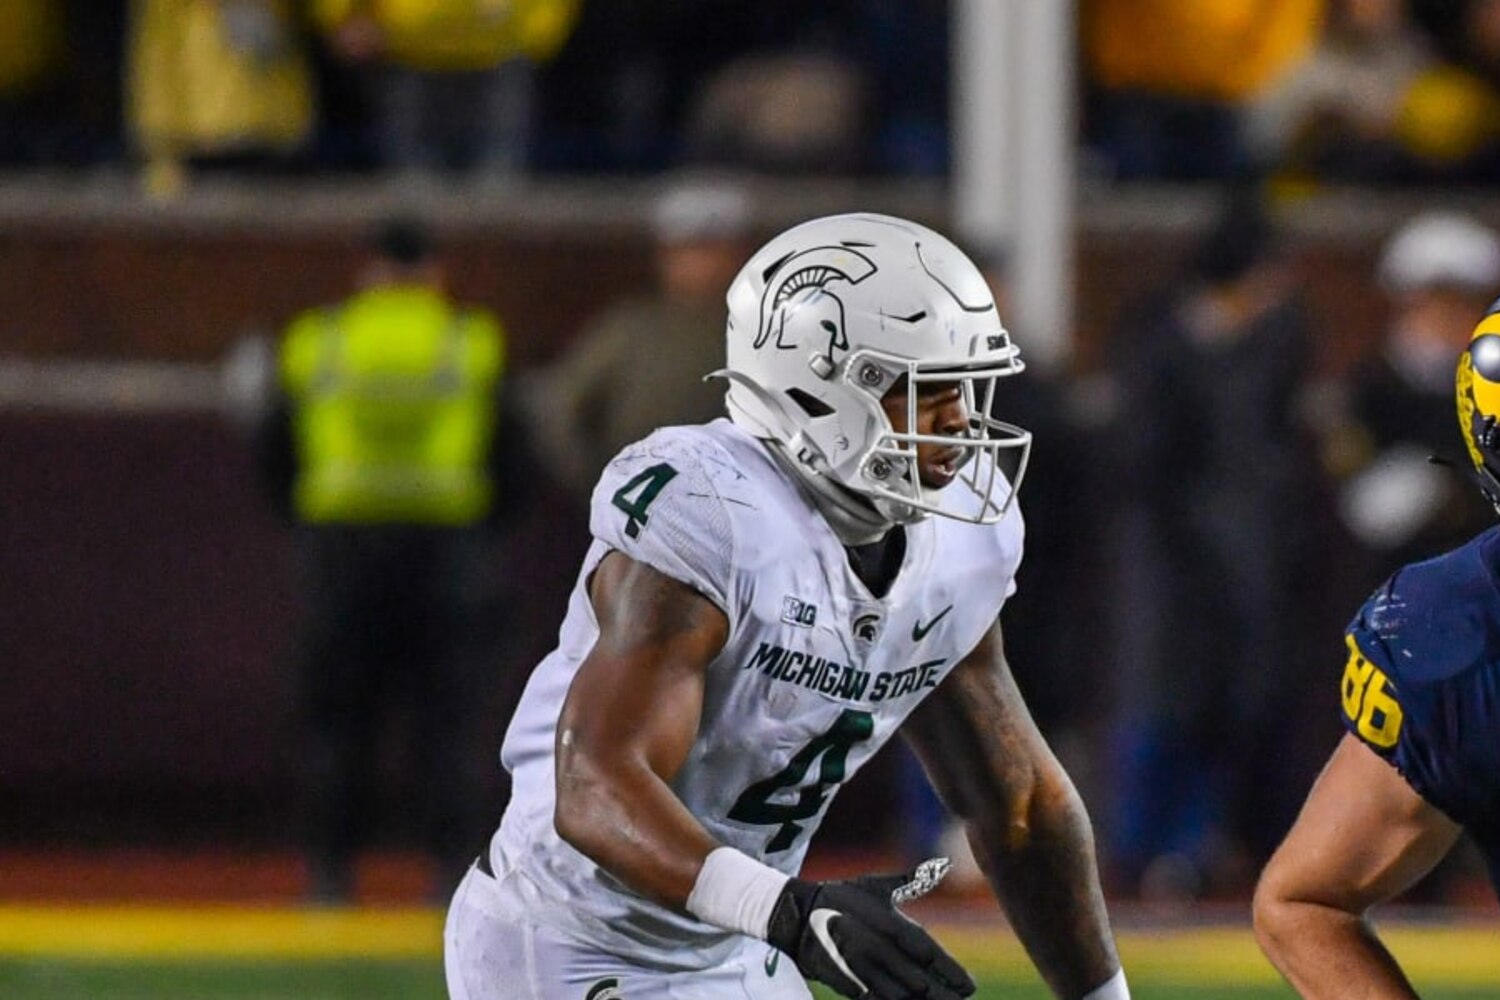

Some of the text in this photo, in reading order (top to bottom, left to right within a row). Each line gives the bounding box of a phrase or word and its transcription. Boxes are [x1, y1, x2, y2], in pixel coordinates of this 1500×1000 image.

[611, 462, 679, 539] 4
[744, 641, 948, 701] MICHIGAN STATE
[1341, 633, 1403, 747] 86
[726, 708, 874, 854] 4
